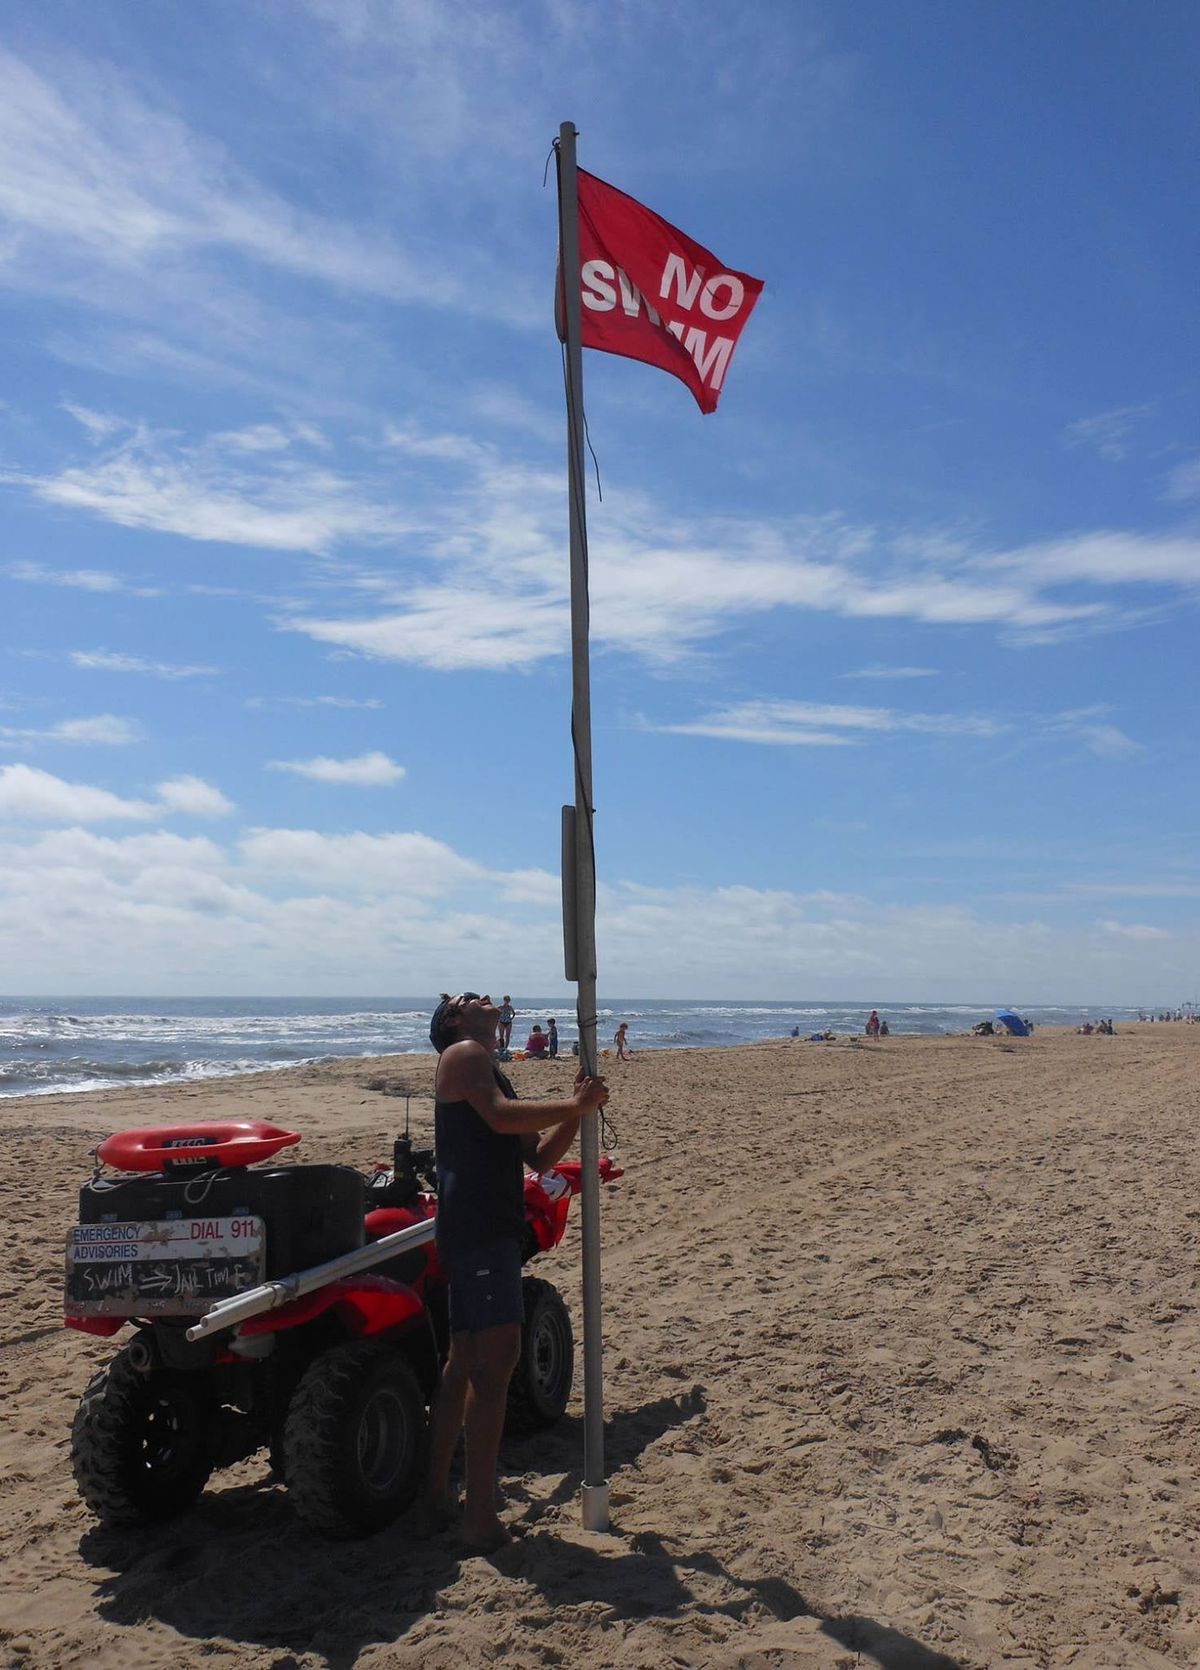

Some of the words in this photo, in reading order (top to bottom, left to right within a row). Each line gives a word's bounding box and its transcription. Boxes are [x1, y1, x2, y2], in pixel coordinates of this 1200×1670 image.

[659, 251, 745, 321] NO
[73, 1226, 141, 1242] EMERGENCY
[191, 1221, 224, 1240] DIAL
[231, 1219, 255, 1239] 911
[73, 1244, 138, 1259] ADVISORIES
[83, 1263, 133, 1292] SWIM
